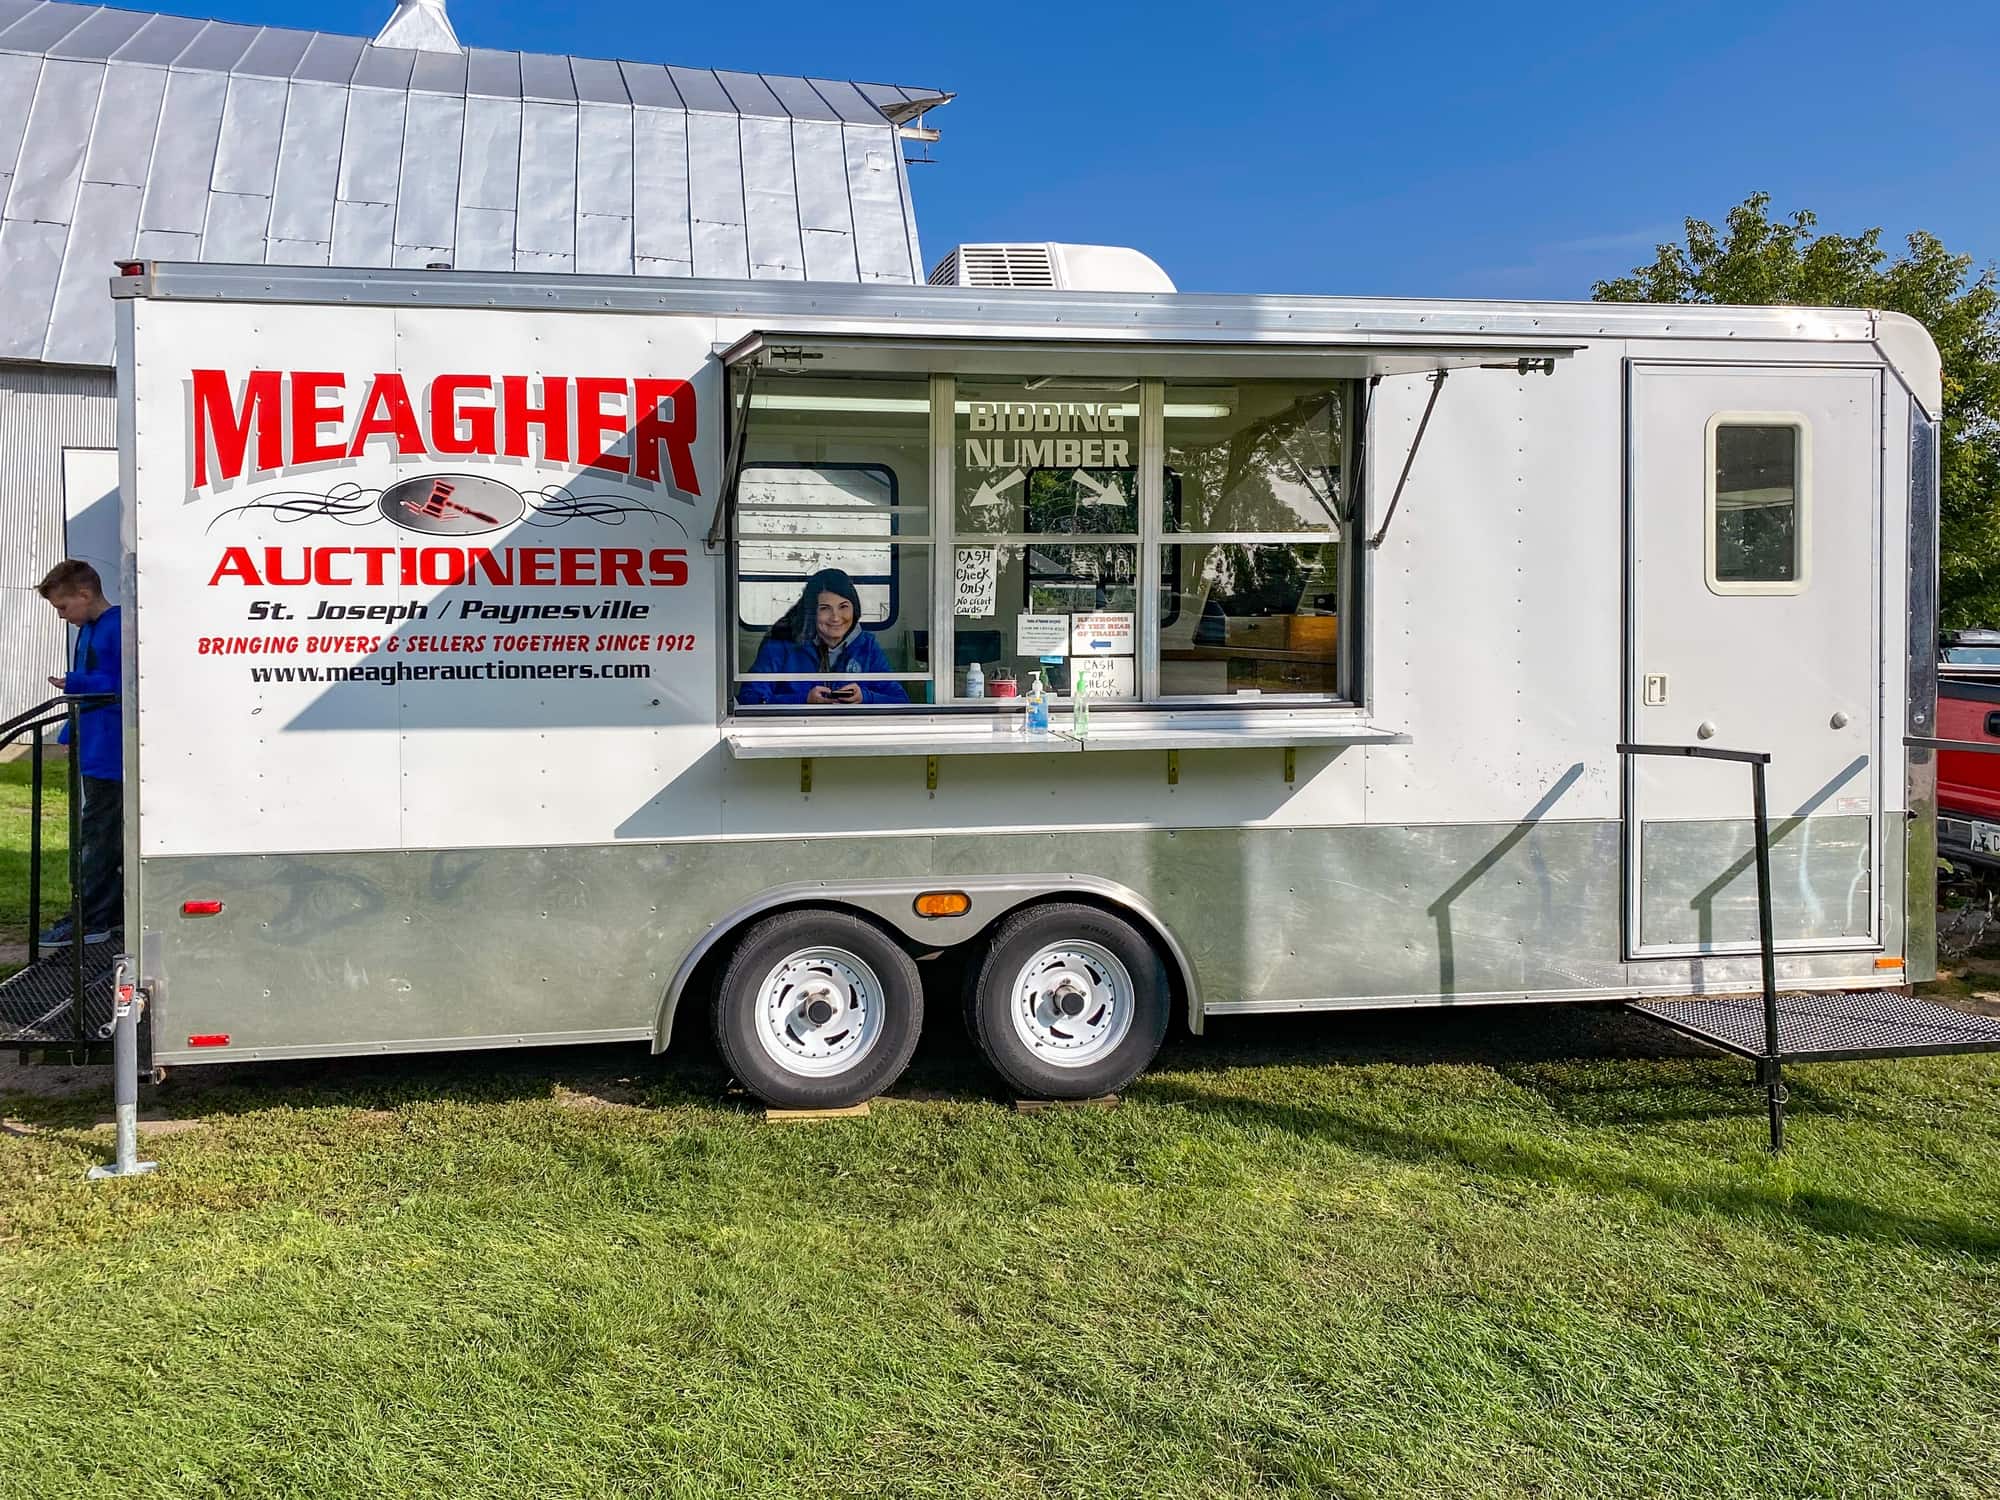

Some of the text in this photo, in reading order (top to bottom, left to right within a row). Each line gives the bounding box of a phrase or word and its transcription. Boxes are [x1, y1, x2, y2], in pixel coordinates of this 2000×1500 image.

[969, 403, 1124, 432] BIDDING
[183, 369, 702, 503] MEAGHER
[965, 439, 1130, 467] NUMBER
[207, 547, 688, 586] AUCTIONEERS
[958, 551, 990, 565] CASH
[248, 600, 294, 620] St.
[307, 600, 428, 624] Joseph
[459, 600, 650, 624] Paynesville
[954, 596, 968, 607] No
[198, 634, 696, 655] BRINGING BUYERS & SELLERS TOGETHER SINCE 1912
[251, 660, 651, 685] www.meagherauctioneers.com
[1083, 660, 1114, 670] CASH
